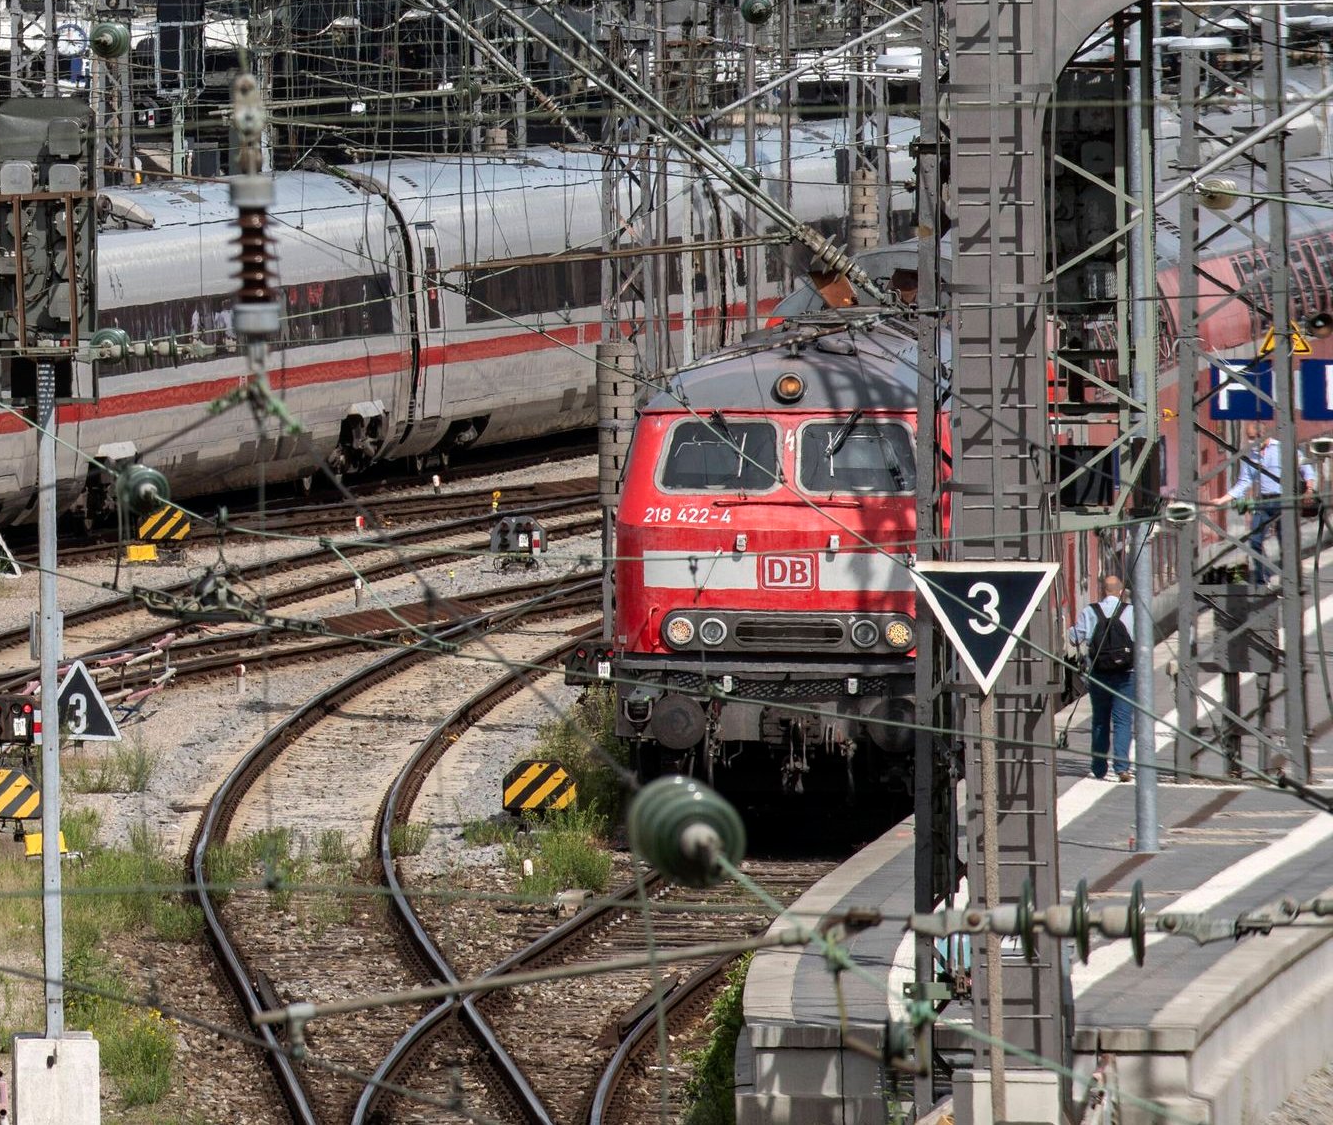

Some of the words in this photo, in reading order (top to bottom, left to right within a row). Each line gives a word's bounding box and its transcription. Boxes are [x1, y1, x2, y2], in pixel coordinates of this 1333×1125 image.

[643, 507, 671, 523] 218
[677, 507, 732, 524] 422-4
[767, 559, 809, 584] DB
[967, 581, 1002, 636] 3
[68, 693, 87, 735] 3
